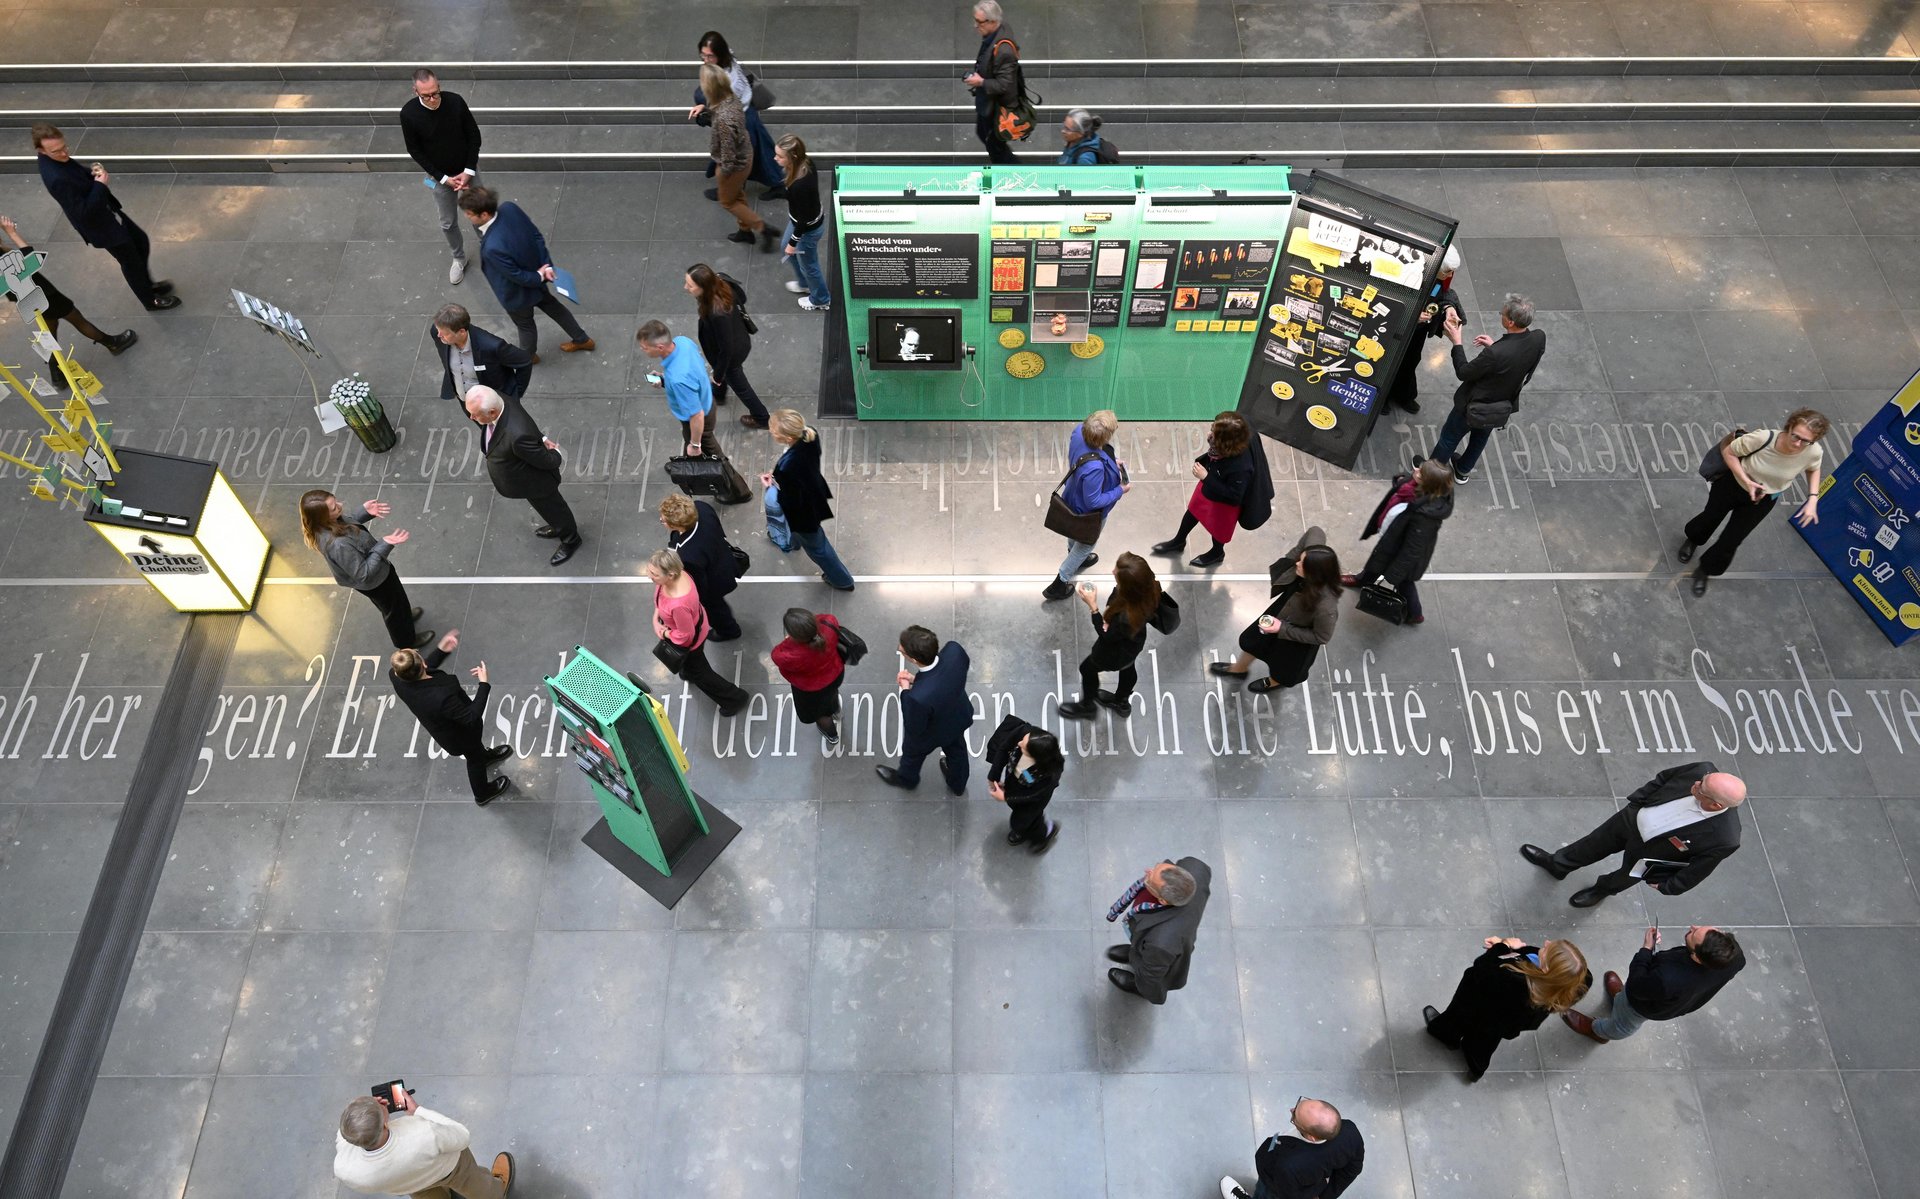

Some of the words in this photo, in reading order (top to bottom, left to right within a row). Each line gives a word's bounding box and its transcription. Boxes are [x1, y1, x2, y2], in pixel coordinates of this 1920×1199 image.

[851, 237, 891, 245] Abschied
[1331, 385, 1370, 404] denkst
[1350, 381, 1372, 396] Was
[1343, 397, 1367, 411] DU?
[919, 424, 1149, 512] vwickelt
[1861, 478, 1889, 507] COMMUNITY
[1847, 525, 1868, 539] SPEECH
[1852, 521, 1866, 532] HATE
[133, 555, 199, 566] Deine
[141, 565, 203, 573] Challenge!
[41, 652, 142, 761] her
[325, 655, 396, 759] Er
[712, 650, 799, 759] den
[1203, 648, 1279, 757] die
[1301, 648, 1453, 779] Lüfte,
[1450, 647, 1542, 756] bis
[1556, 689, 1612, 756] er
[1612, 652, 1697, 753] im
[1691, 647, 1863, 755] Sande
